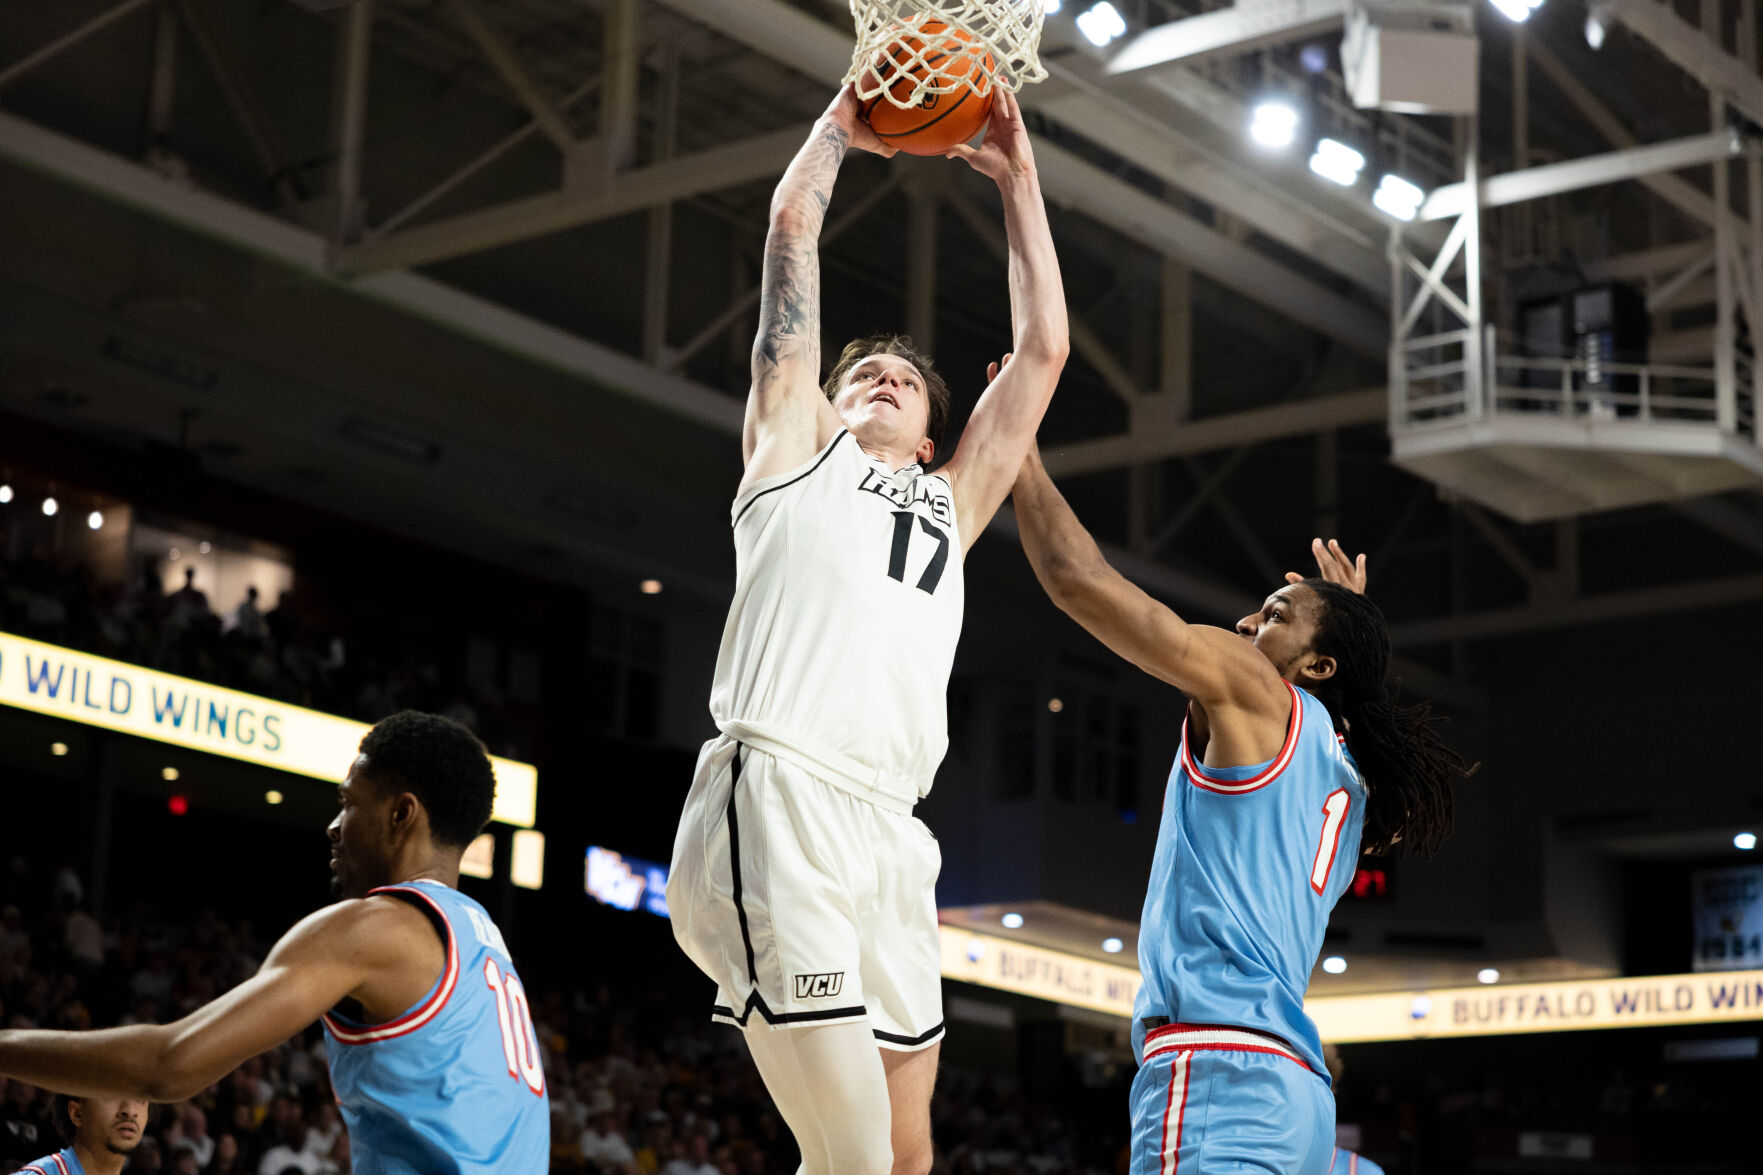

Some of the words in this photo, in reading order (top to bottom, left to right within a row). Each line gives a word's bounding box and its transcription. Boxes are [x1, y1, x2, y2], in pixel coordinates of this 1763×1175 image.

[887, 511, 949, 596] 17
[26, 654, 132, 715] WILD
[152, 684, 281, 752] WINGS
[1311, 786, 1351, 897] 1
[484, 956, 544, 1099] 10
[795, 972, 844, 998] VCU
[1453, 991, 1596, 1024] BUFFALO
[1610, 985, 1693, 1014] WILD
